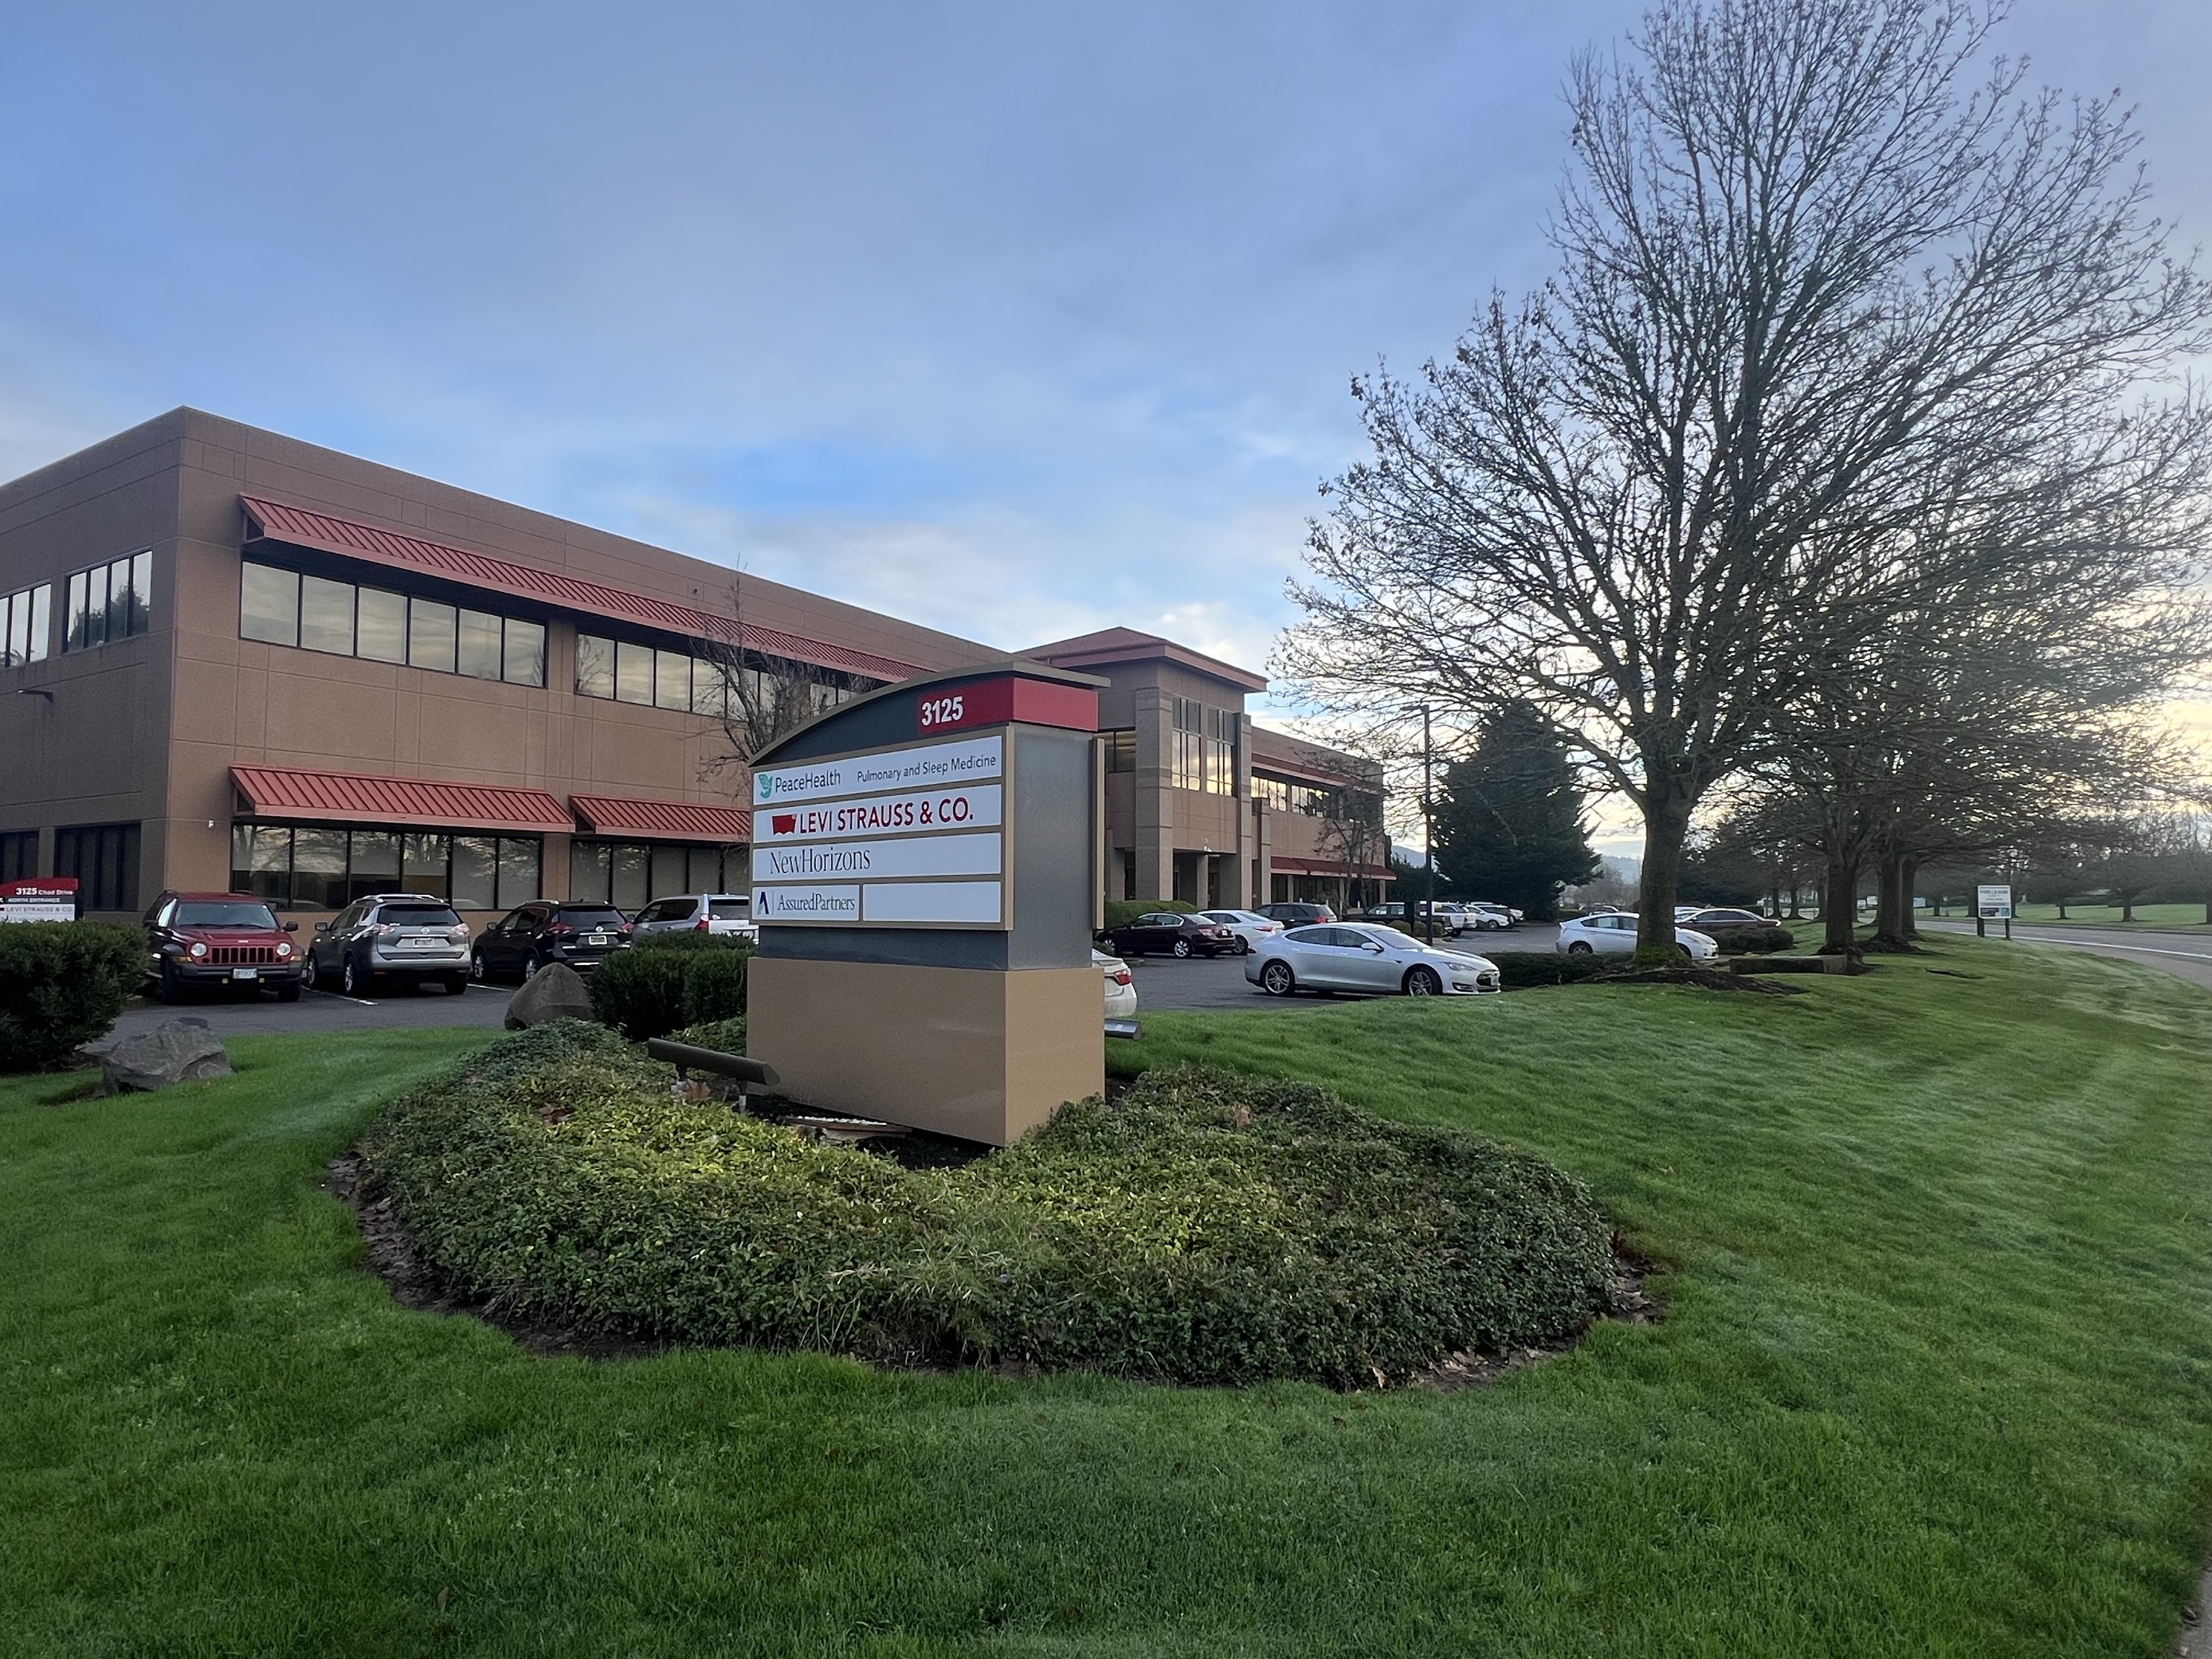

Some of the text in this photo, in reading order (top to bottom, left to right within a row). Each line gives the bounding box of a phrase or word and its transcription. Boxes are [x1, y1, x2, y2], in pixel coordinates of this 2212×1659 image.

[921, 696, 963, 726] 3125
[775, 768, 841, 794] PeaceHealth
[857, 755, 997, 782] Pulmonary and Sleep Medicine
[799, 797, 974, 833] LEVI STRAUSS & CO.
[770, 846, 871, 875] NewHorizons
[777, 892, 856, 911] AssuredPartners
